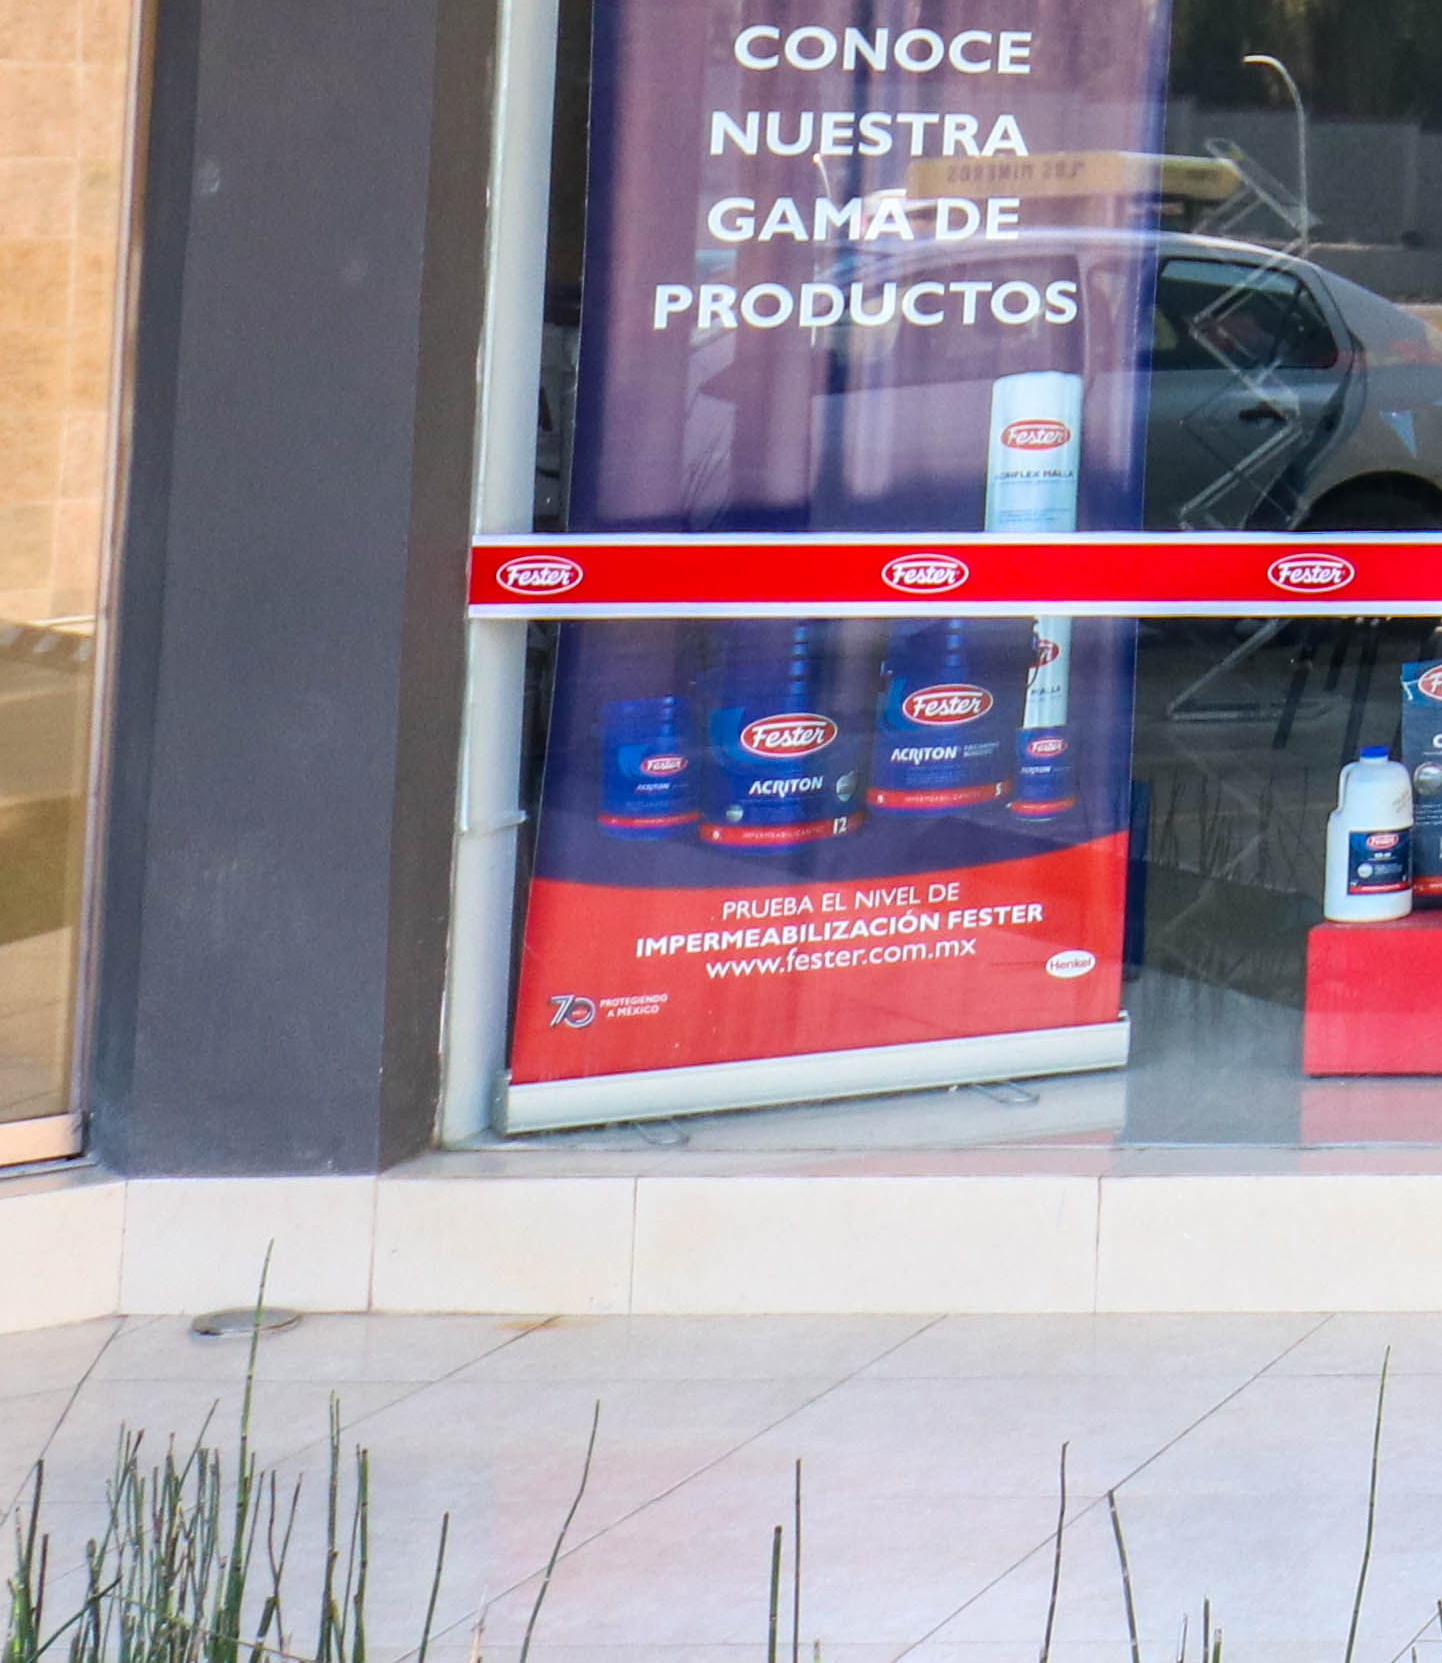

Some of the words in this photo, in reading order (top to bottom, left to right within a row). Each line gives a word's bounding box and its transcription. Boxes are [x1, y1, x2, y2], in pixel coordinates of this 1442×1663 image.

[733, 25, 1032, 74] CONOCE
[709, 111, 1029, 158] NUESTRA
[707, 196, 913, 241] GAMA
[936, 196, 1020, 241] DE
[653, 280, 1079, 330] PRODUCTOS
[751, 721, 828, 749] Fester
[890, 746, 958, 765] ACRITON
[748, 776, 824, 797] ACRITON
[832, 817, 848, 835] 12
[722, 895, 815, 920] PRUEBA
[822, 891, 848, 913] EL
[854, 886, 921, 910] NIVEL
[929, 883, 960, 903] DE
[636, 909, 940, 958] IMPERMEABILIZACIÓN
[947, 903, 1044, 930] FESTER
[706, 937, 976, 980] www.fester.com.mx
